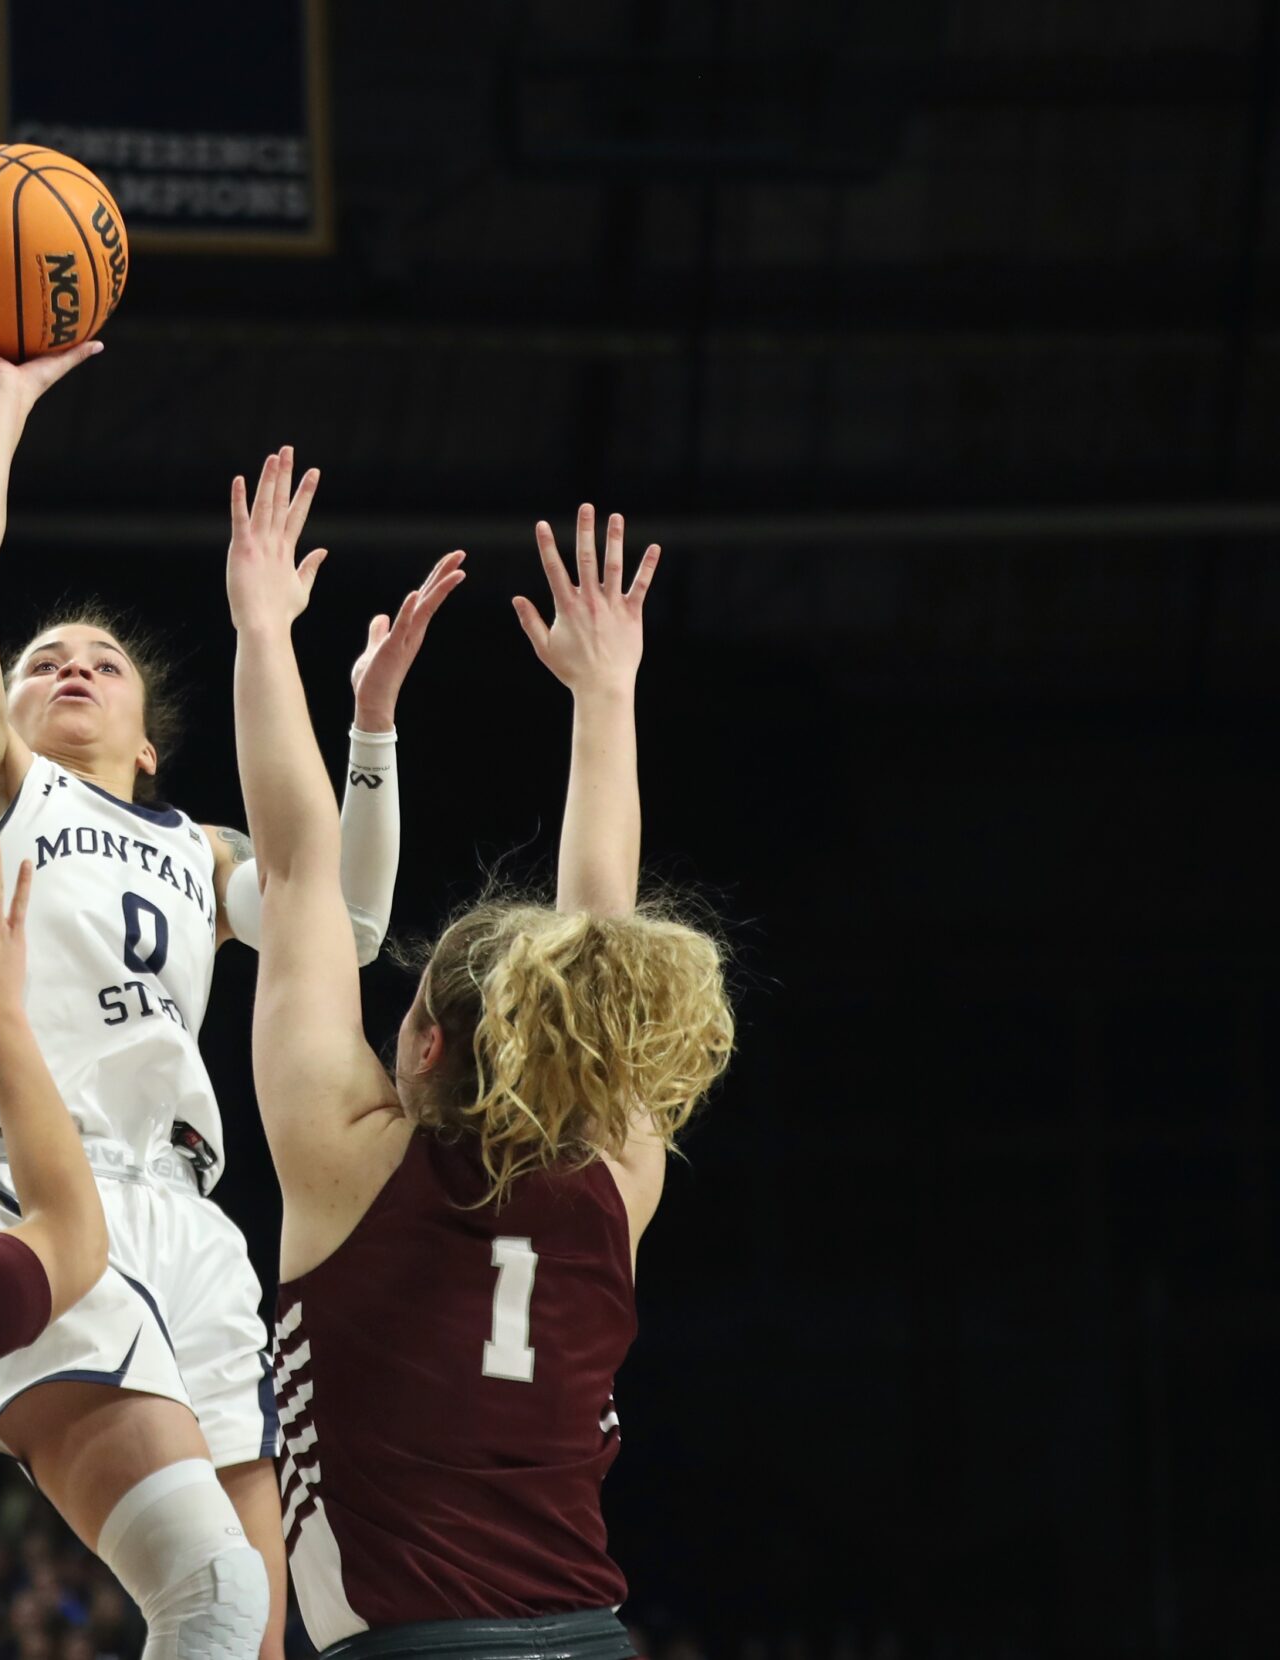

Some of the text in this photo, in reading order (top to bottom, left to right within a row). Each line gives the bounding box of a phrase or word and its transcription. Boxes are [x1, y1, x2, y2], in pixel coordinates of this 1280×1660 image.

[108, 172, 310, 219] MPIONS
[45, 253, 80, 348] NCAA
[91, 201, 126, 318] Wils
[121, 891, 169, 974] 0
[482, 1236, 538, 1383] 1
